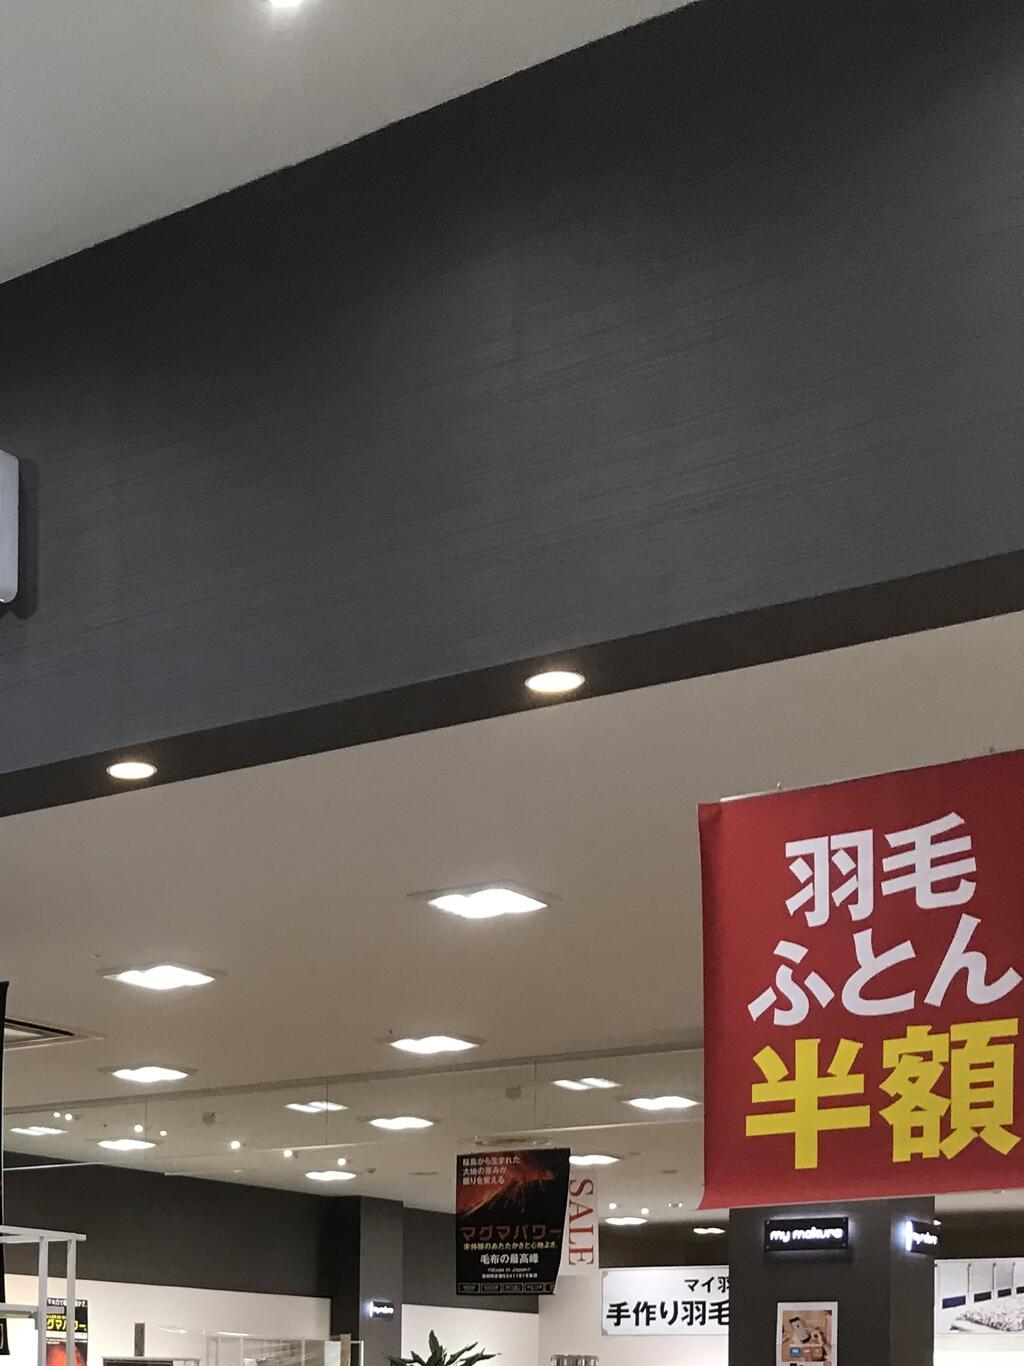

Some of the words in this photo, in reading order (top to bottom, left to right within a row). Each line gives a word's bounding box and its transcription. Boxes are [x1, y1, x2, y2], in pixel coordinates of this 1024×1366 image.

[784, 811, 977, 928] 羽毛
[747, 913, 1023, 1026] ふとん
[745, 1018, 1022, 1169] 半額
[461, 1224, 562, 1241] マグマパワー
[480, 1253, 539, 1265] 毛布の最高峰
[568, 1178, 594, 1265] SALE
[606, 1300, 729, 1326] 手作り羽毛
